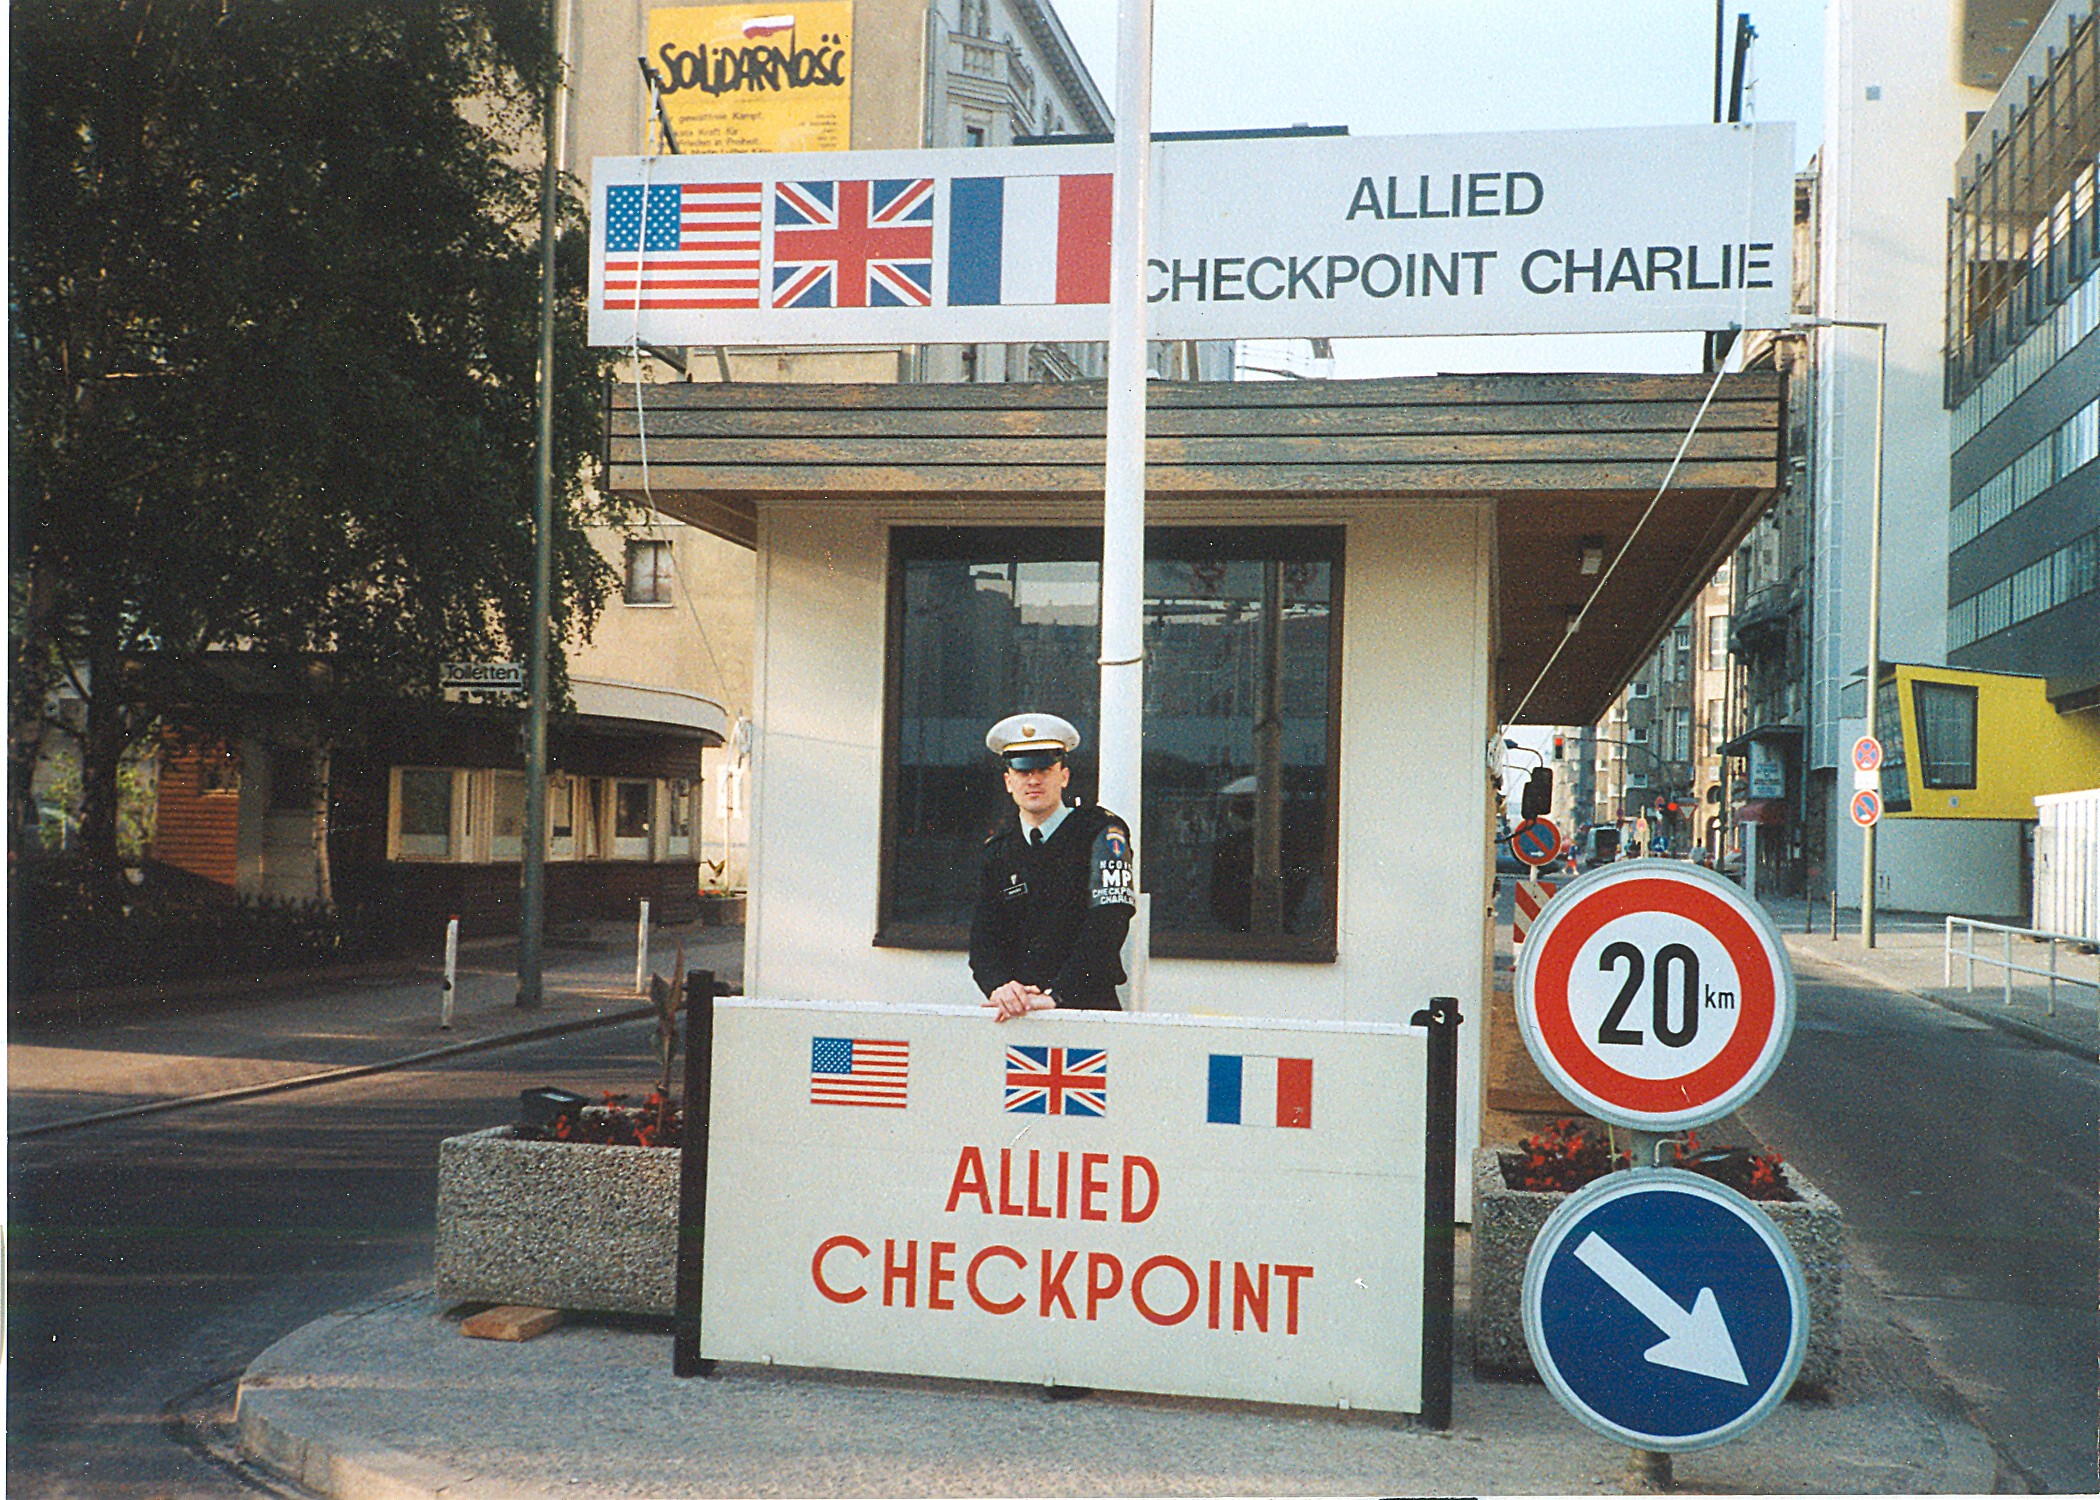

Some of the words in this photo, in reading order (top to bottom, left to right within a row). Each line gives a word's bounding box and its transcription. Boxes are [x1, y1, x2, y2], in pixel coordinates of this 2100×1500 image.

[1346, 171, 1544, 220] ALLIED
[1147, 250, 1497, 302] CHECKPOINT
[1520, 243, 1773, 294] CHARLIE
[1103, 869, 1132, 888] MP
[1597, 942, 1700, 1048] 20
[1705, 983, 1735, 1009] km
[944, 1145, 1161, 1224] ALLIED
[811, 1234, 1315, 1335] CHECKPOINT
